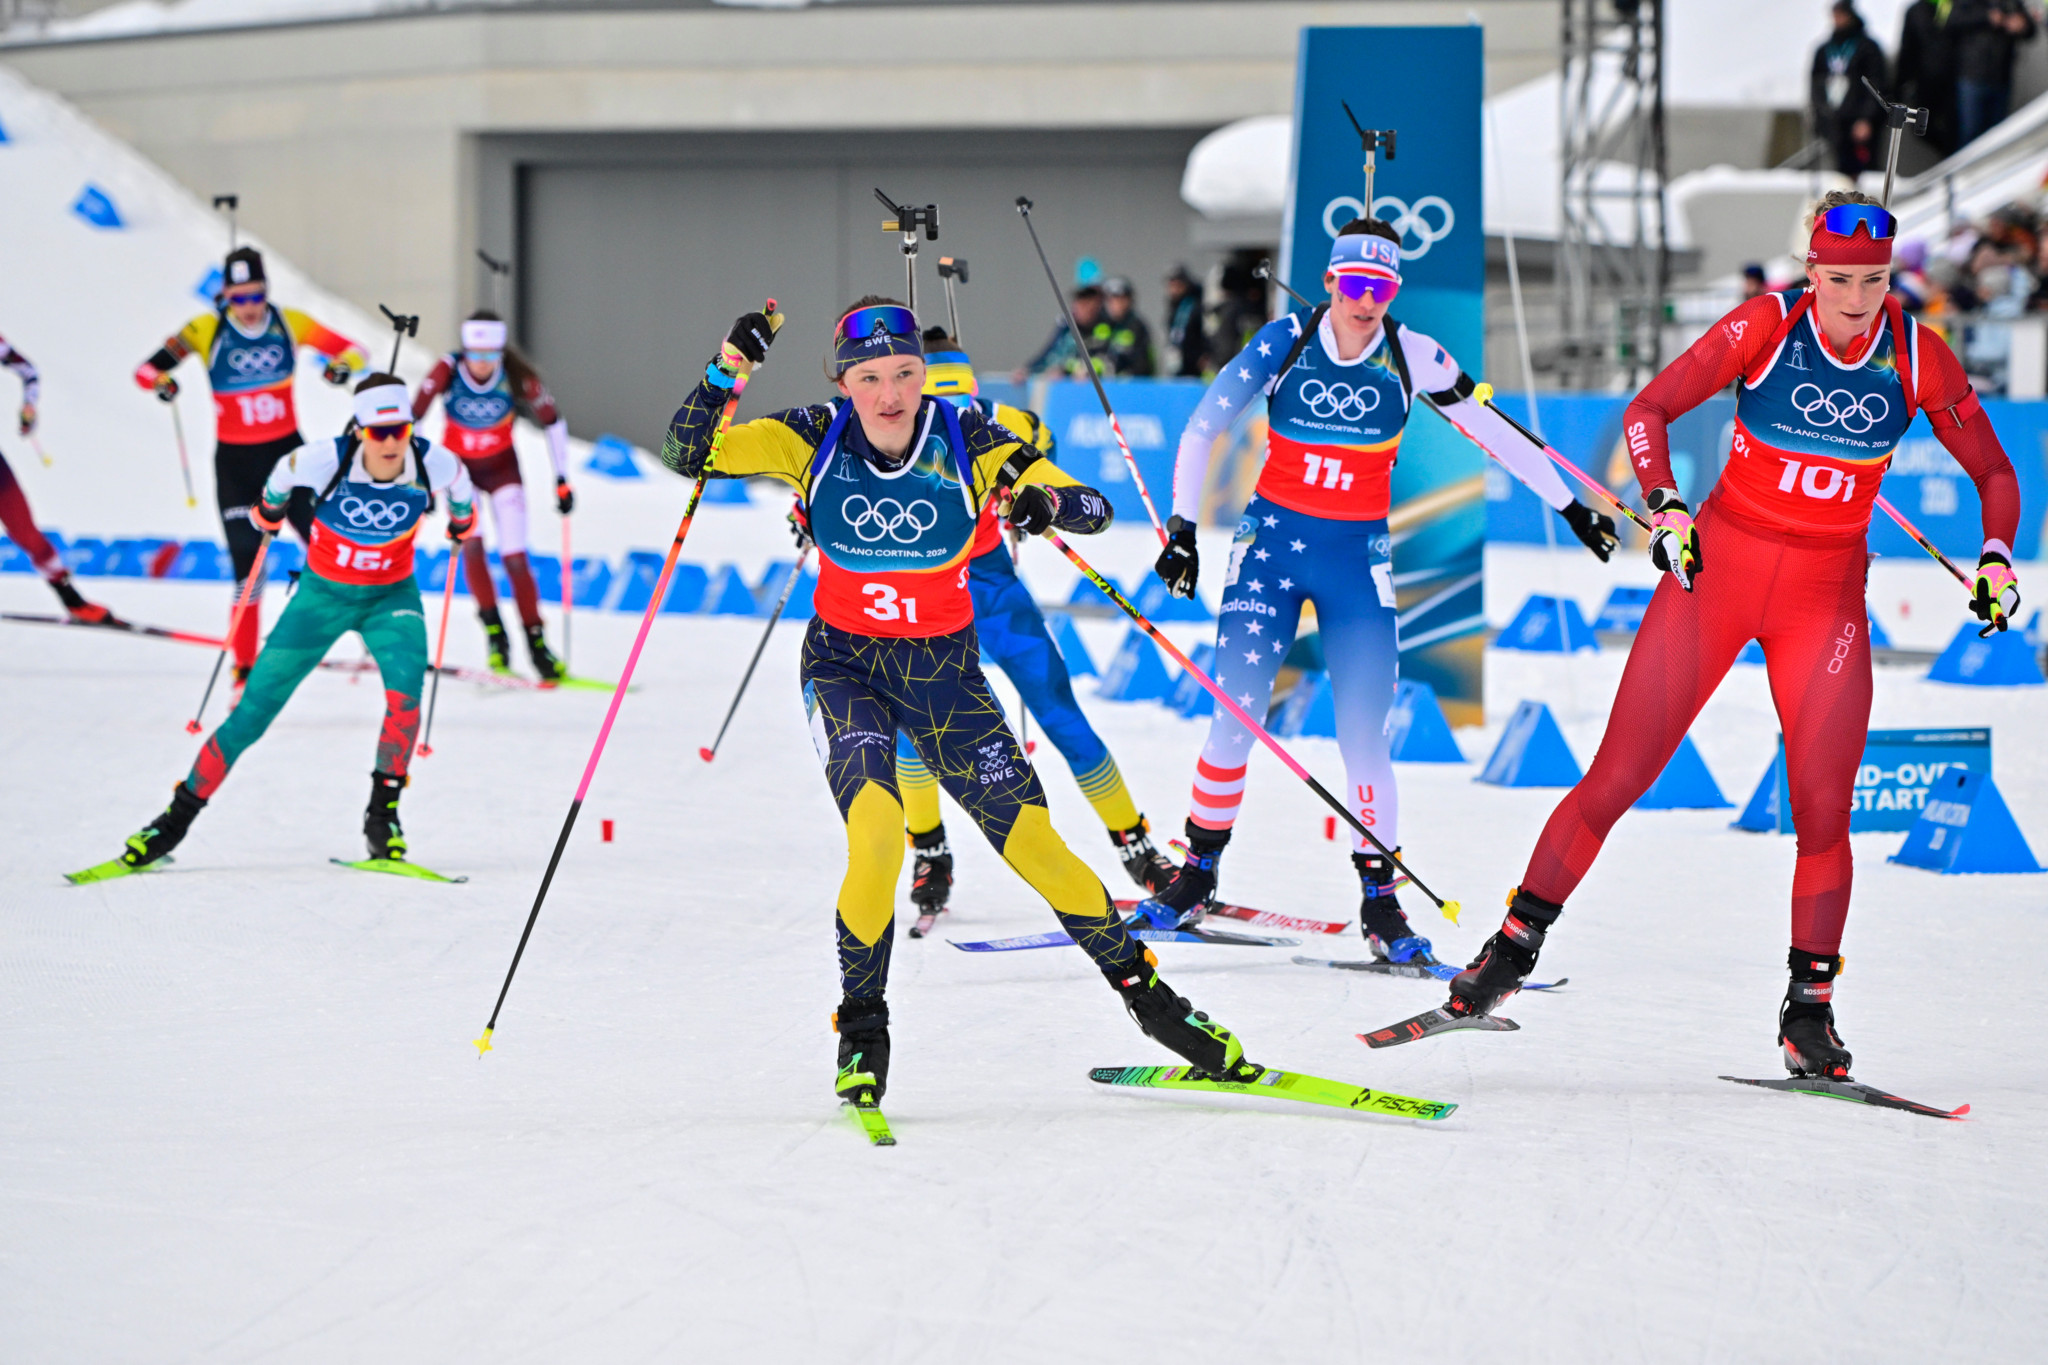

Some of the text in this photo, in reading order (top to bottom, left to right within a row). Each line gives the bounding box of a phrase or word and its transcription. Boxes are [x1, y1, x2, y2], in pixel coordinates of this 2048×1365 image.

[1361, 239, 1399, 271] USA
[864, 335, 892, 348] SWE
[1289, 417, 1325, 430] MILANO
[1325, 423, 1363, 434] CORTINA
[1770, 422, 1890, 448] MILANO CORTINA 2026
[1628, 421, 1651, 457] SUI
[1777, 457, 1857, 502] 101
[831, 541, 948, 558] MILANO CORTINA 2026
[861, 582, 919, 624] 31
[1827, 622, 1856, 674] odlo
[979, 765, 1016, 786] SWE
[1138, 930, 1178, 942] SALOMON
[1371, 1095, 1446, 1118] FISCHER
